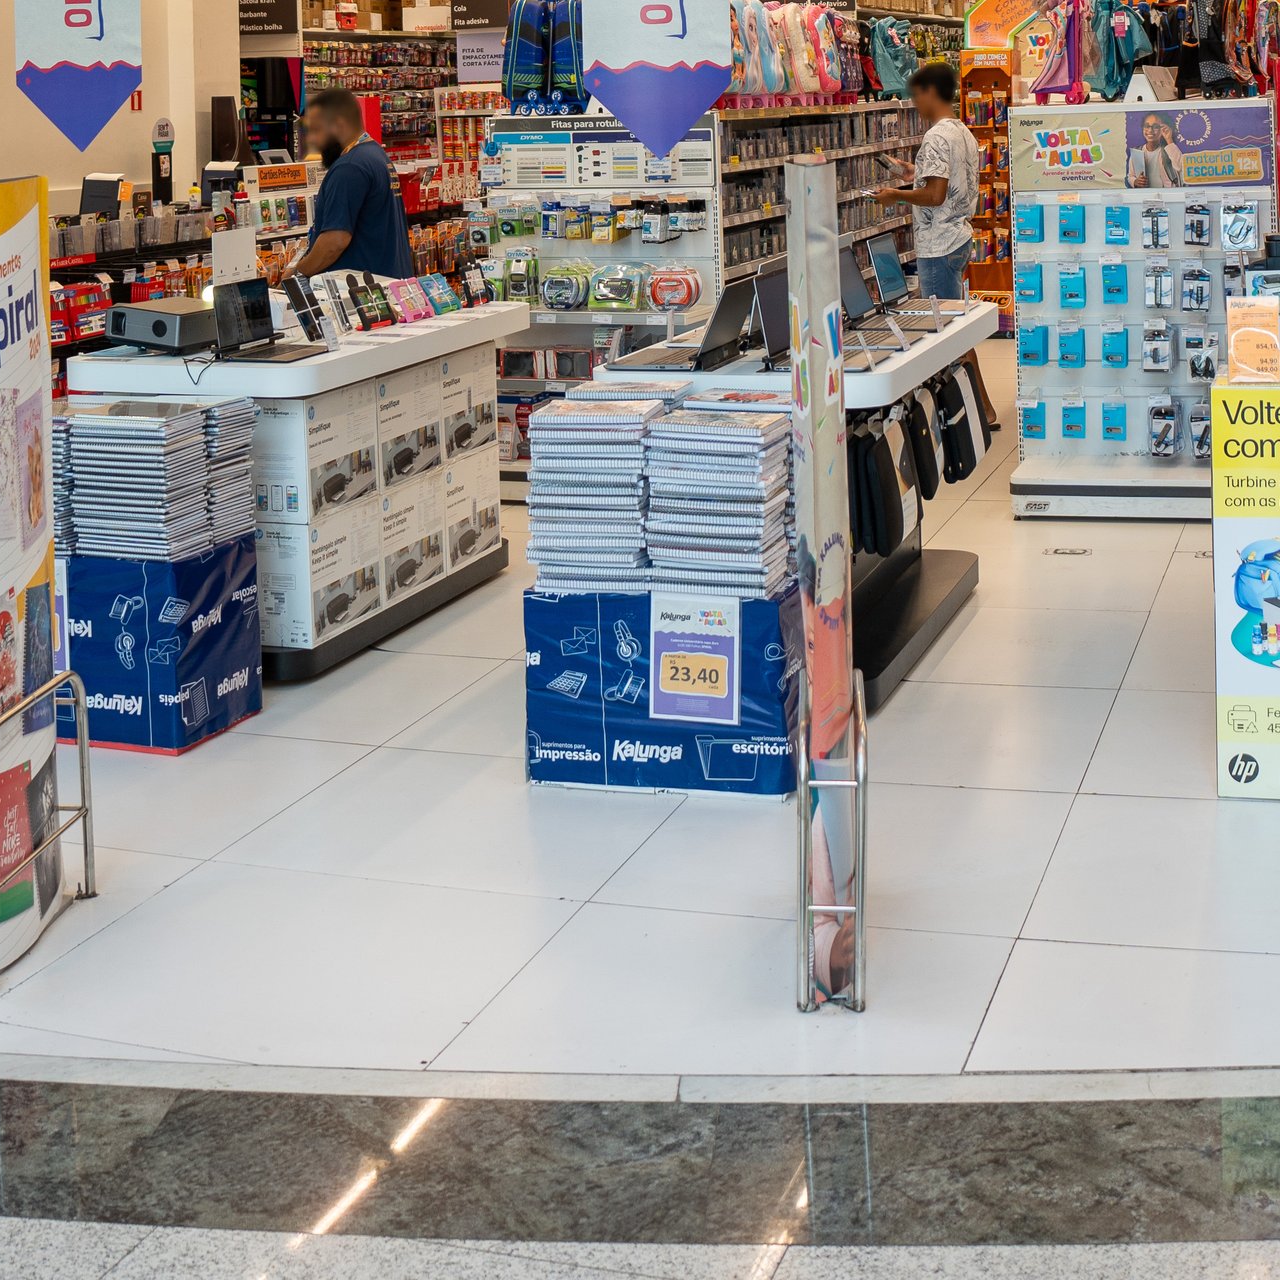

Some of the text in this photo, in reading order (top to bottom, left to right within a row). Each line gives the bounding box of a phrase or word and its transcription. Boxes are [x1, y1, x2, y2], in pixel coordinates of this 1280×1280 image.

[239, 11, 267, 19] Barbante
[468, 17, 488, 25] adesiva
[265, 23, 282, 31] bolha
[551, 120, 594, 130] Fitas para
[1035, 130, 1092, 148] VOLTA
[1049, 146, 1102, 168] AULAS
[1187, 165, 1235, 177] ESCOLAR
[443, 376, 461, 388] Simplifique
[380, 399, 400, 411] Simplifique
[308, 421, 331, 436] Simplifique
[1224, 475, 1276, 488] Turbine
[1025, 503, 1049, 511] FAST
[1225, 497, 1255, 507] com
[1259, 497, 1276, 507] as
[670, 667, 719, 685] 23,40
[536, 747, 601, 763] impressão
[732, 742, 793, 756] escritório
